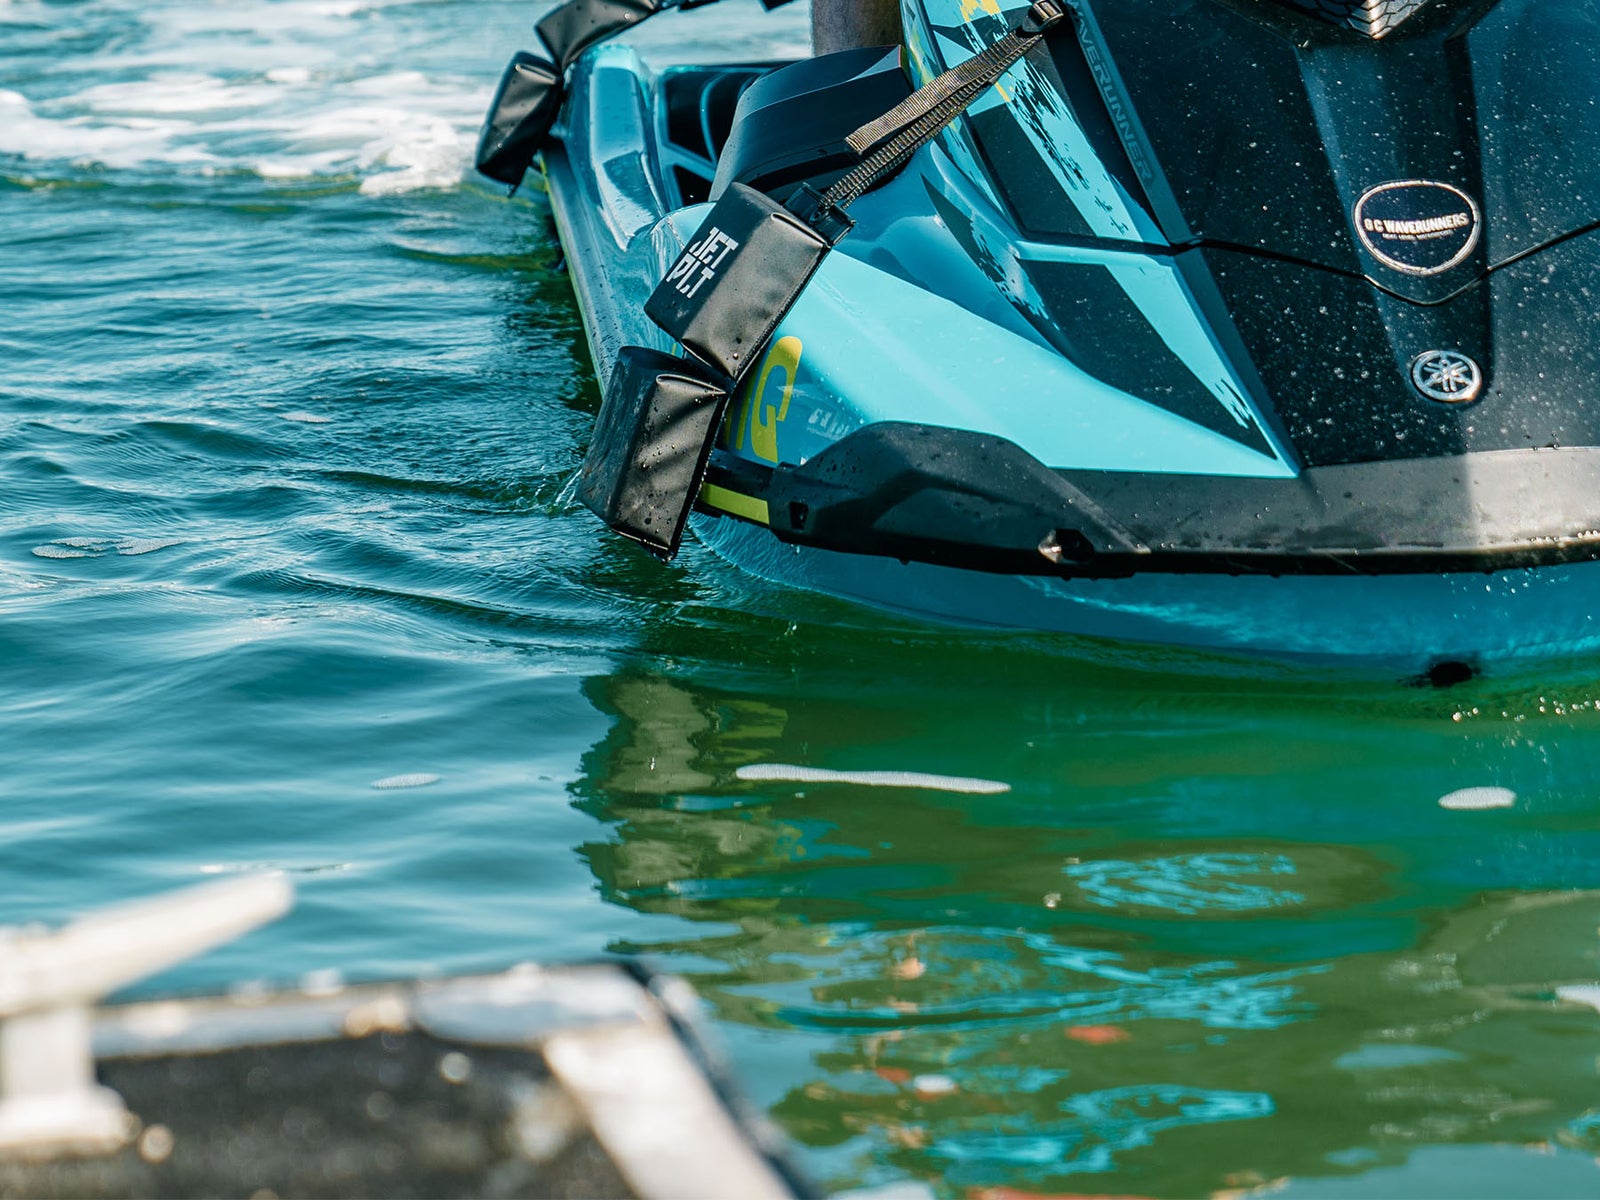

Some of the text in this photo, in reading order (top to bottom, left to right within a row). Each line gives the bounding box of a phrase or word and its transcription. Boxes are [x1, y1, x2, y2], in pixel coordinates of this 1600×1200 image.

[1383, 212, 1470, 235] WAVERUNNERS
[688, 226, 739, 270] JET
[665, 252, 716, 299] PLT
